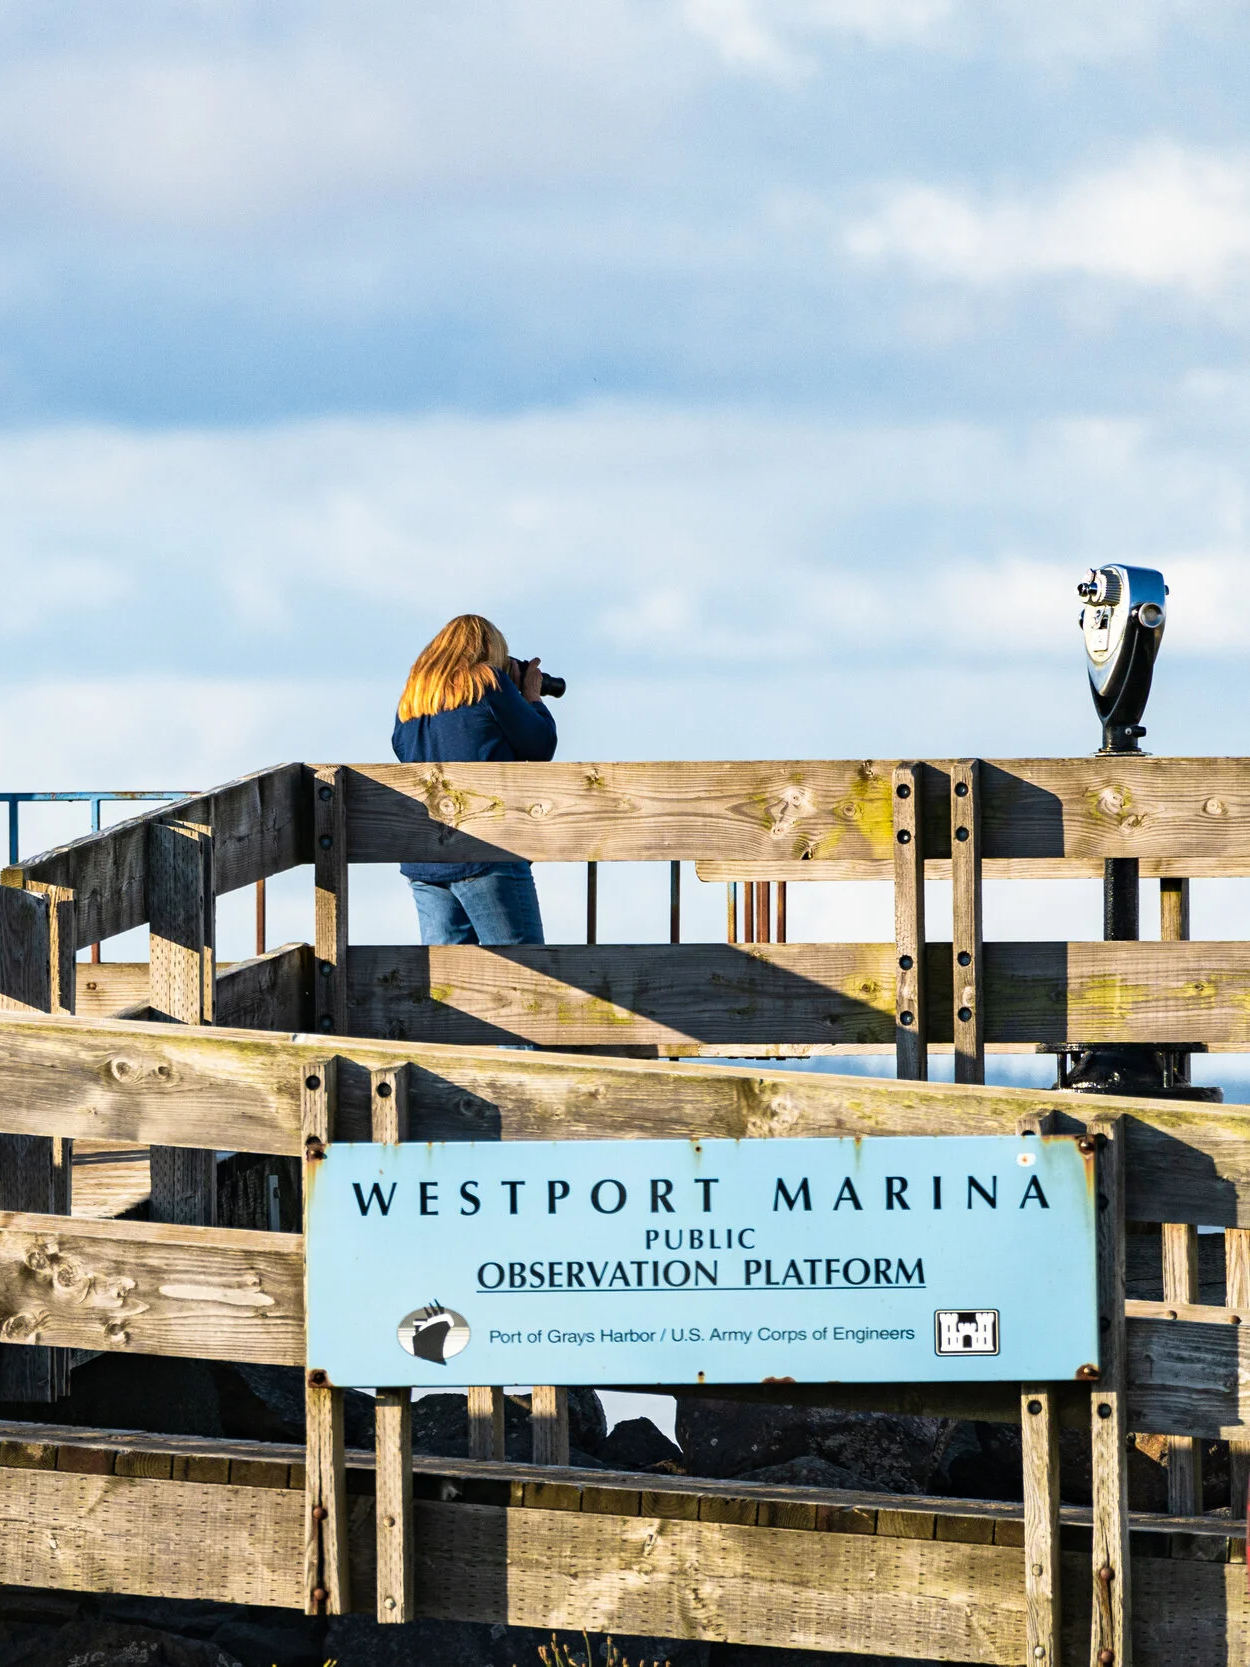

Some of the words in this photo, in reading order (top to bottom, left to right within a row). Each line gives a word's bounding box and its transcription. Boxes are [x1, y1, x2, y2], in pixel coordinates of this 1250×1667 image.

[351, 1178, 720, 1217] WESTPORT
[772, 1174, 1050, 1212] MARINA
[645, 1227, 756, 1251] PUBLIC
[477, 1259, 719, 1290] OBSERVATION
[744, 1257, 927, 1287] PLATFORM
[489, 1330, 522, 1344] Port
[526, 1329, 543, 1344] of
[547, 1329, 596, 1347] Grays
[600, 1328, 657, 1343] Harbor
[671, 1327, 706, 1343] U.S.
[709, 1327, 753, 1345] Army
[757, 1327, 808, 1344] Corps
[812, 1326, 829, 1341] of
[833, 1326, 916, 1344] Engineers
